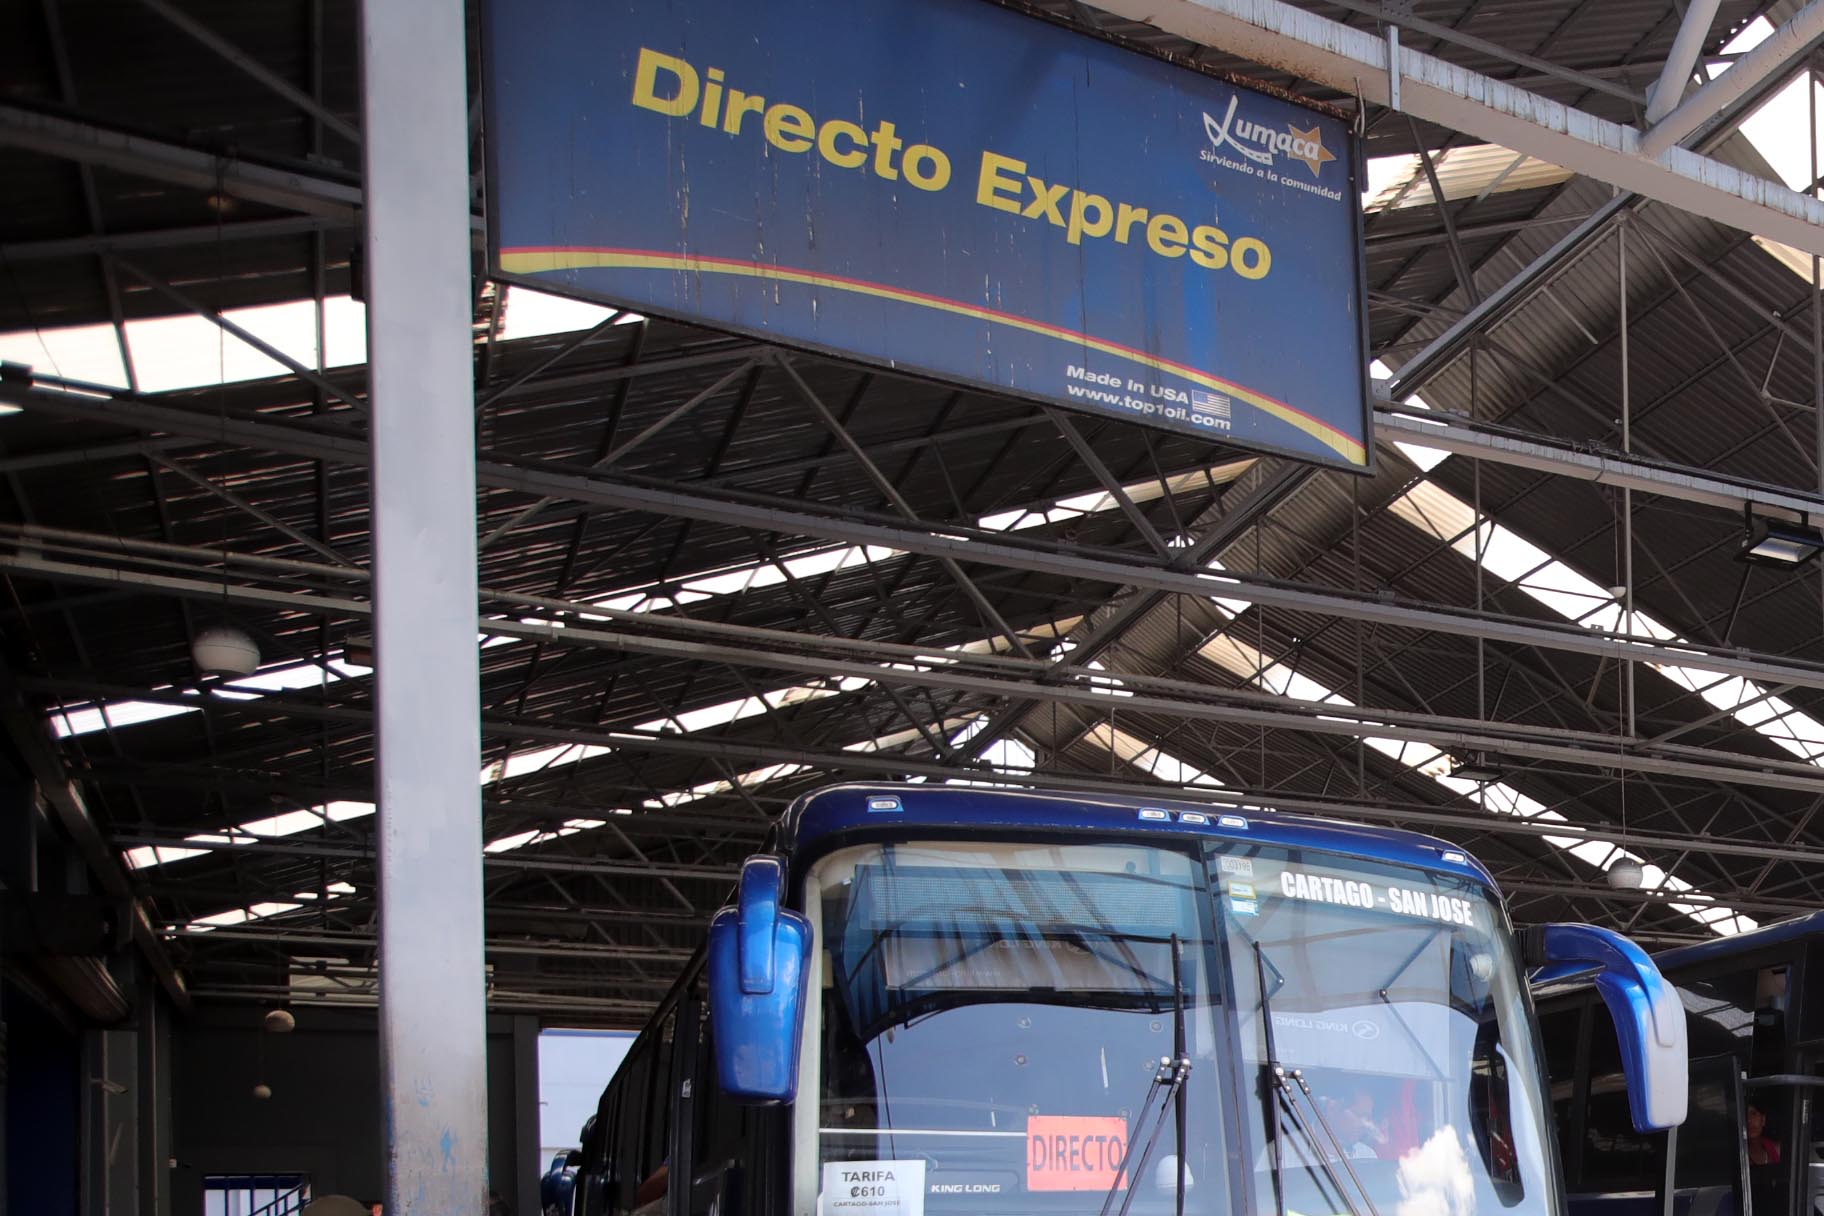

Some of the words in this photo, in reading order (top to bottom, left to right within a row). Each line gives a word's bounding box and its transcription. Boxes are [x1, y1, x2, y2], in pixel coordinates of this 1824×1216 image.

[1202, 94, 1320, 166] Lumaca
[630, 47, 951, 192] Directo
[976, 150, 1272, 281] Expreso
[1200, 149, 1254, 175] Sirviendo
[1256, 169, 1264, 178] a
[1267, 170, 1278, 182] la
[1280, 176, 1342, 201] comunidad
[1066, 365, 1122, 388] Made
[1127, 379, 1145, 394] In
[1151, 384, 1189, 404] USA
[1067, 384, 1231, 430] www.top1oil.com
[1280, 871, 1374, 909] CARTAGO
[1388, 887, 1429, 918] SAN
[1431, 893, 1474, 926] JOSE
[841, 1171, 895, 1182] TARIFA
[1032, 1135, 1123, 1172] DIRECTO
[931, 1184, 963, 1193] KING
[965, 1184, 1001, 1193] LONG
